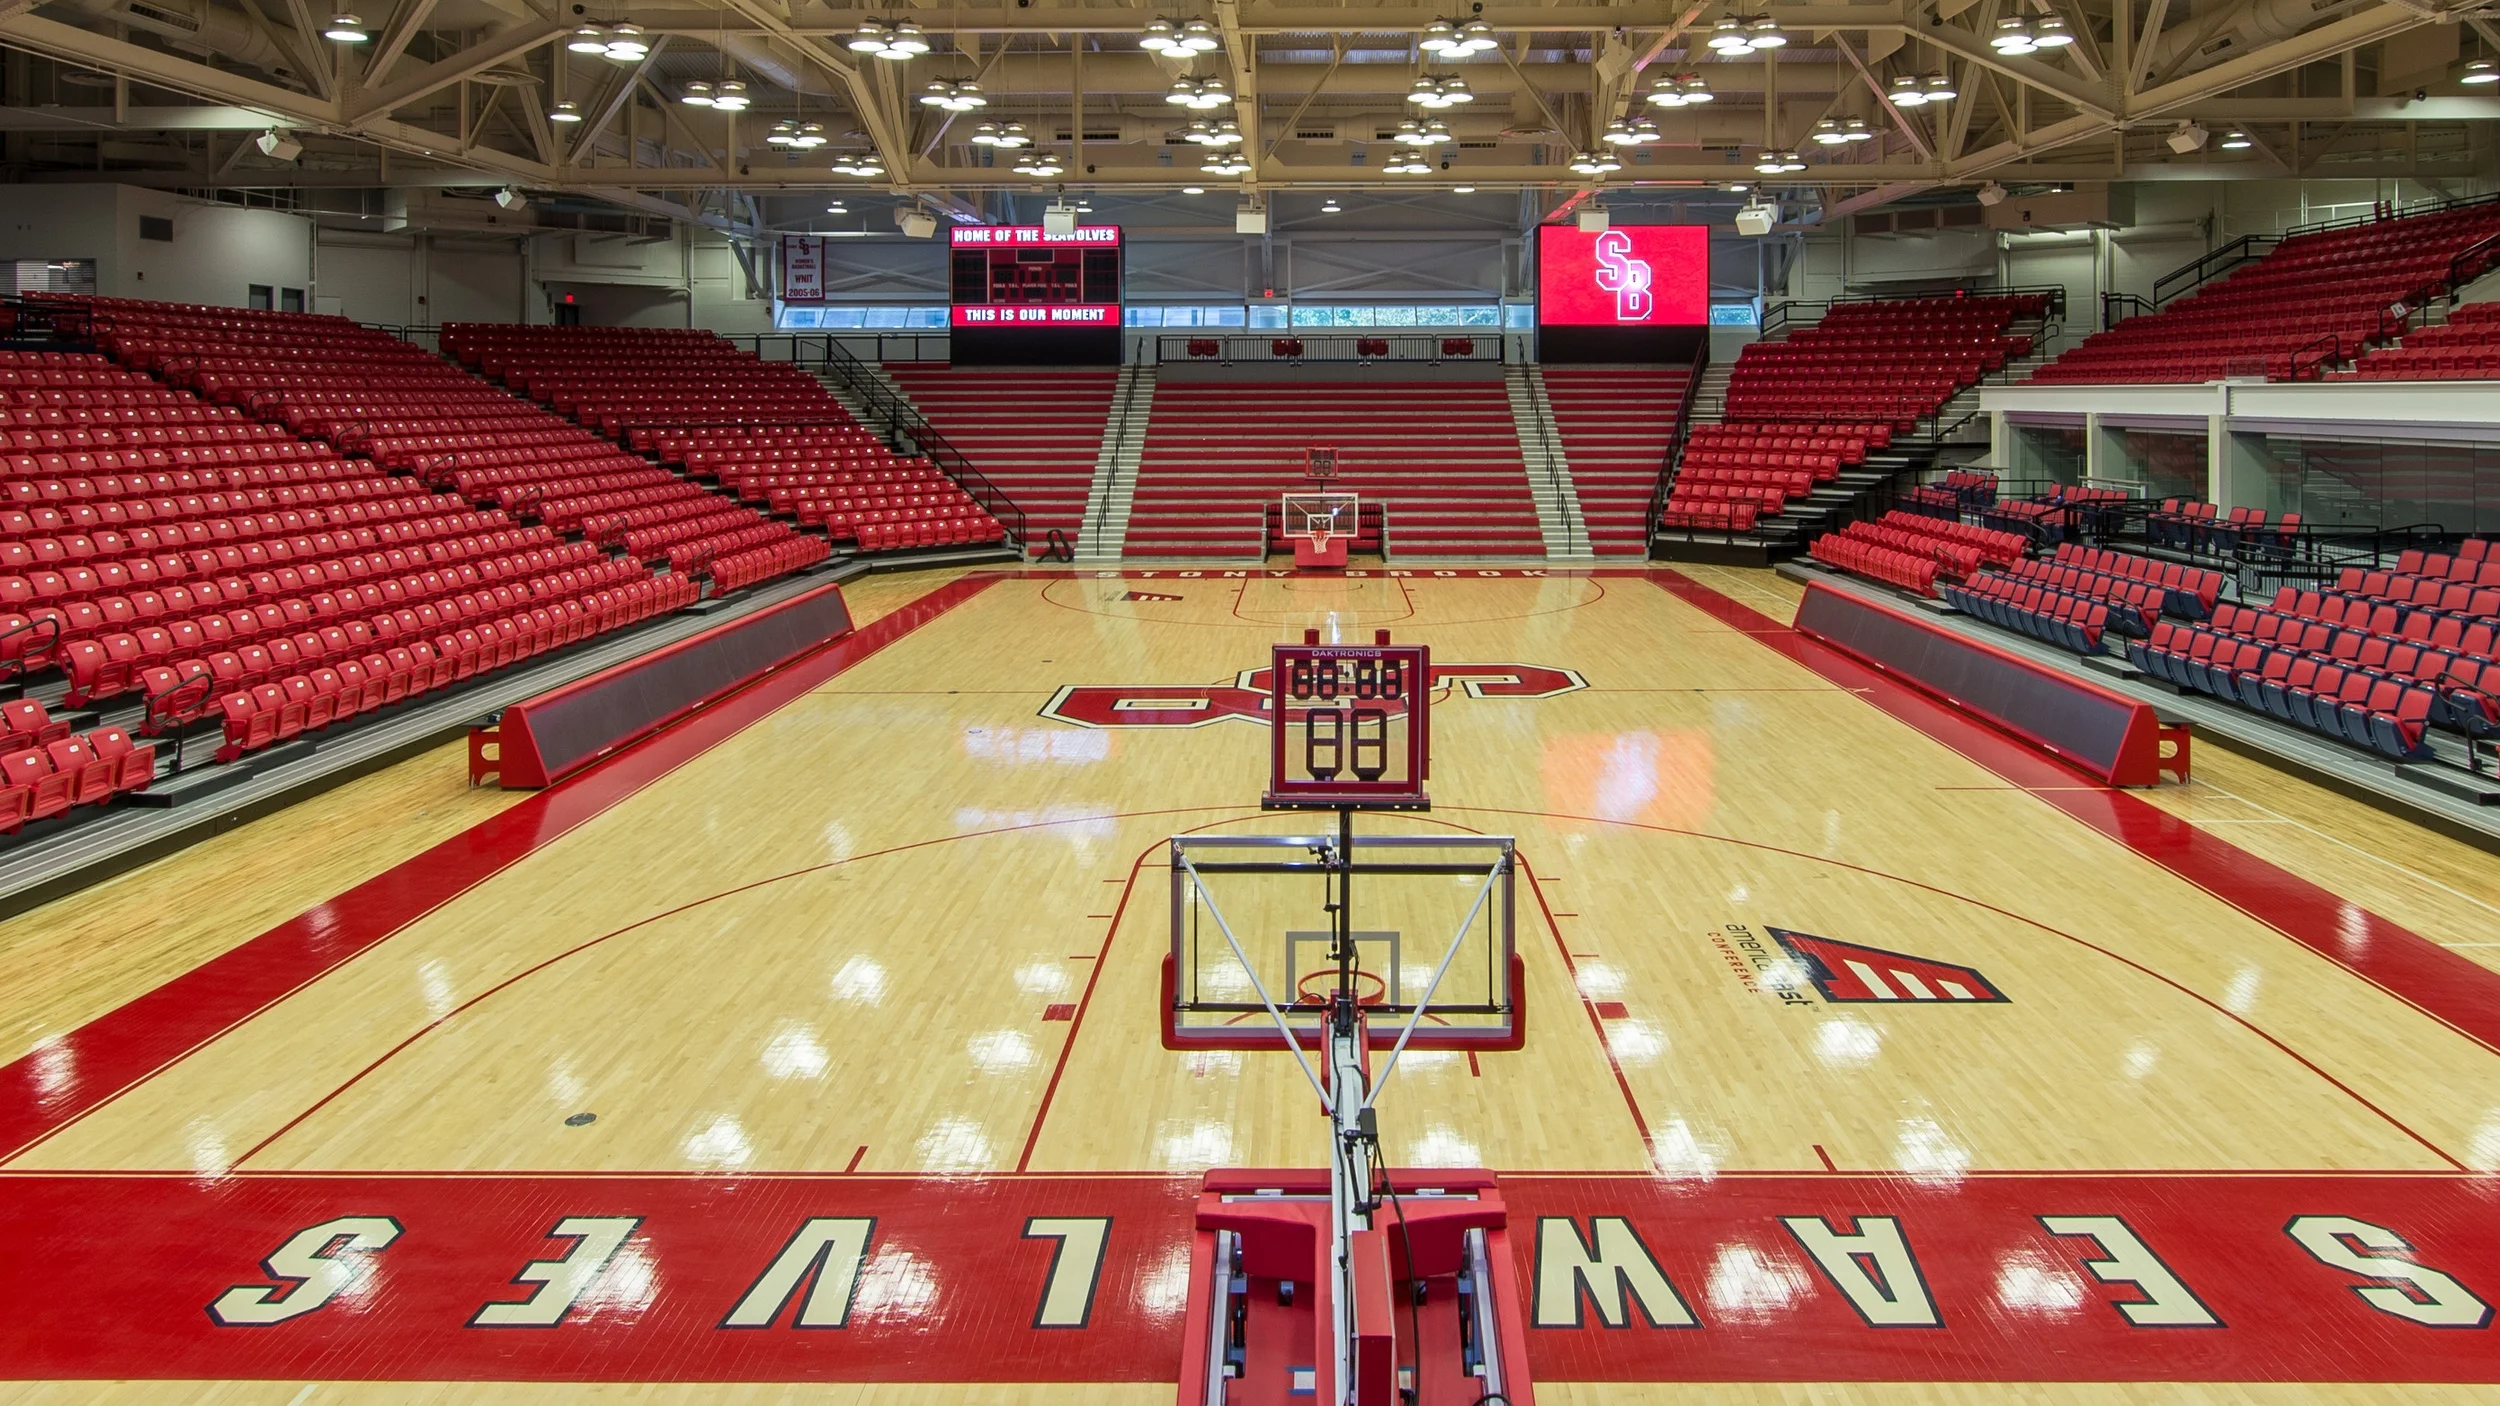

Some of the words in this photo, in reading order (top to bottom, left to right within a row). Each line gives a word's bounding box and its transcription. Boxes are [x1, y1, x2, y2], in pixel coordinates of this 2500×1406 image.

[954, 229, 991, 242] HOME
[995, 229, 1012, 242] OF
[1015, 229, 1039, 242] THE
[795, 275, 813, 283] WNIT
[789, 288, 819, 296] 2005-06
[965, 308, 995, 321] THIS
[1000, 308, 1015, 321] IS
[1019, 308, 1046, 321] OUR
[1051, 308, 1105, 321] MOMENT
[1094, 570, 1290, 578] STONY
[1311, 649, 1382, 658] DAKTRONICS
[1707, 931, 1762, 994] CONFERENCE
[204, 1214, 2496, 1329] SEAWLVES
